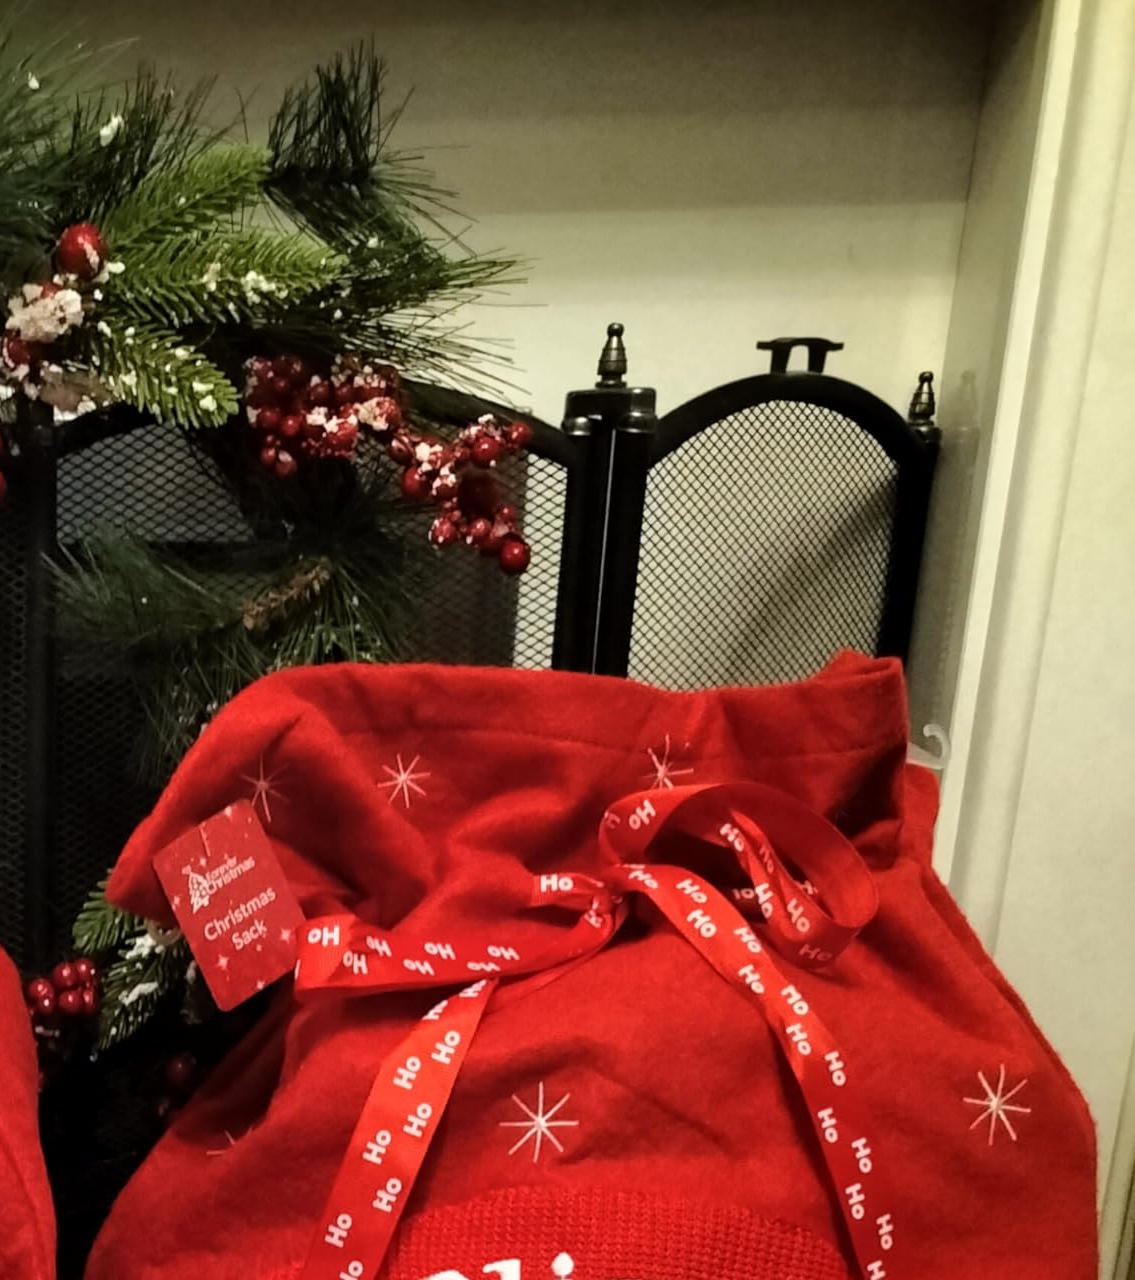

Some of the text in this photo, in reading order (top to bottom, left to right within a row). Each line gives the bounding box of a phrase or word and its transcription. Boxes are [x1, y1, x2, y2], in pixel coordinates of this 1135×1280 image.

[629, 800, 655, 829] Ho
[204, 887, 276, 940] Christmas
[541, 875, 573, 892] Ho
[232, 920, 267, 950] Sack
[308, 926, 339, 946] Ho
[425, 943, 455, 959] Ho
[676, 880, 707, 903] Ho
[734, 927, 761, 952] Ho
[825, 1051, 845, 1085] Ho
[687, 910, 716, 937] Ho
[738, 965, 764, 993] Ho
[786, 1024, 811, 1055] Ho
[325, 1214, 352, 1247] Ho
[363, 1130, 391, 1164] Ho
[394, 1057, 421, 1089] Ho
[373, 1178, 401, 1212] Ho
[404, 1104, 432, 1136] Ho
[432, 1031, 460, 1064] Ho
[818, 1108, 837, 1142] Ho
[846, 1184, 864, 1219] Ho
[852, 1138, 871, 1173] Ho
[877, 1214, 893, 1249] Ho
